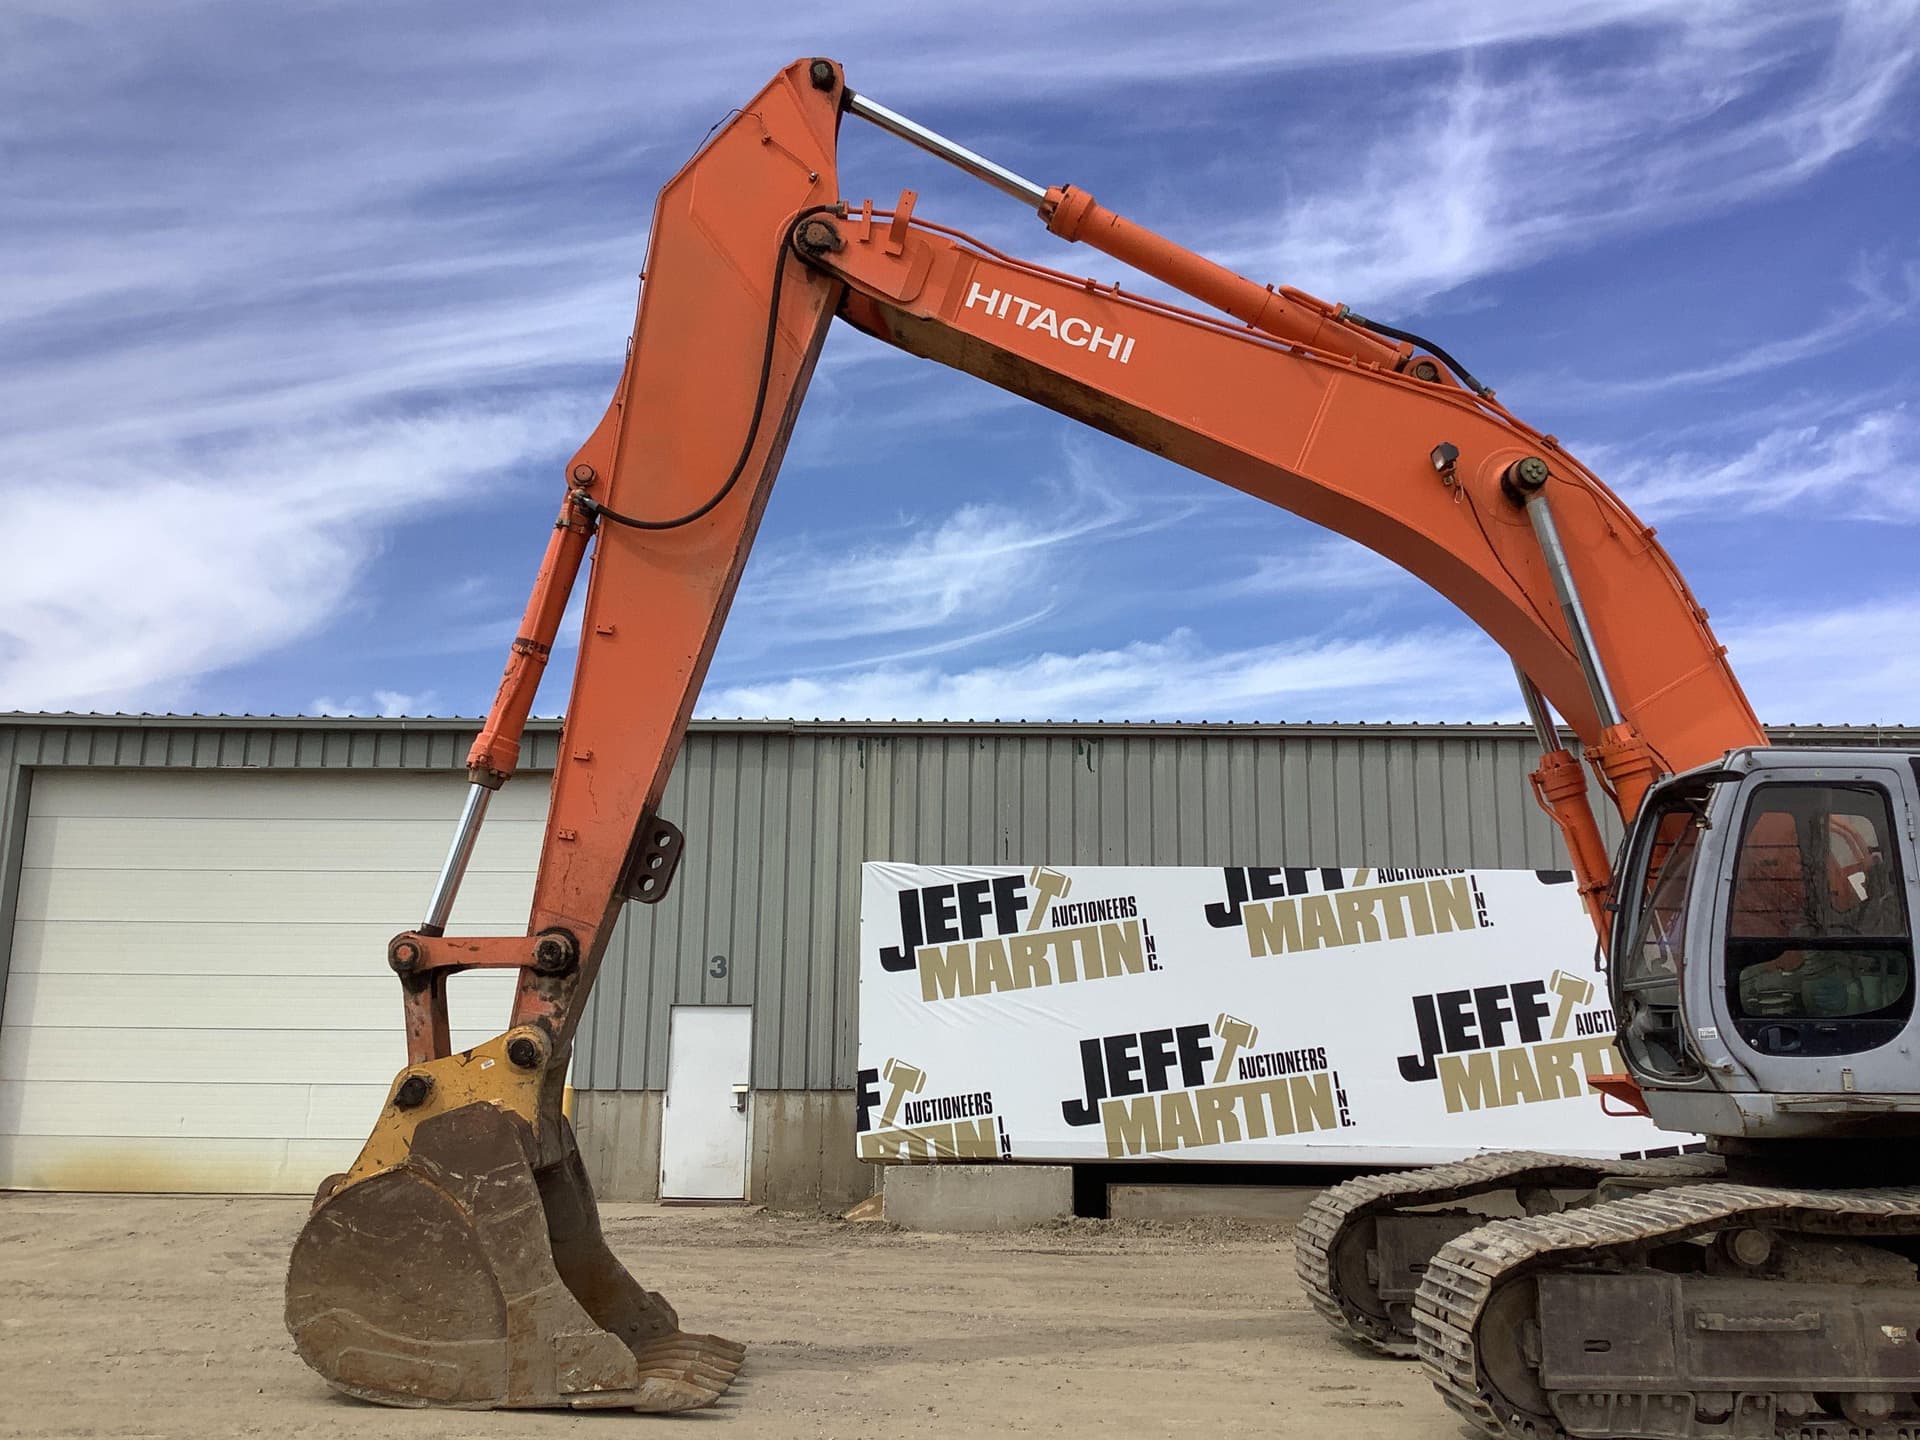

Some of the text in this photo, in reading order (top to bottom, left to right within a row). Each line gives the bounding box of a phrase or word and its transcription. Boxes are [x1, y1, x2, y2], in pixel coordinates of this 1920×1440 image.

[965, 282, 1136, 364] HITACHI
[879, 874, 1029, 973] JEFF
[1051, 896, 1138, 928] AUCTIONEERS
[1243, 876, 1476, 958] MARTIN
[709, 955, 727, 978] 3
[917, 919, 1145, 1002] MARTIN
[1238, 1047, 1328, 1080] AUCTIONEERS
[1397, 980, 1551, 1082] JEFF
[905, 1091, 993, 1125] AUCTIONEERS
[1062, 1023, 1214, 1127] JEFF
[1101, 1072, 1337, 1158] MARTIN
